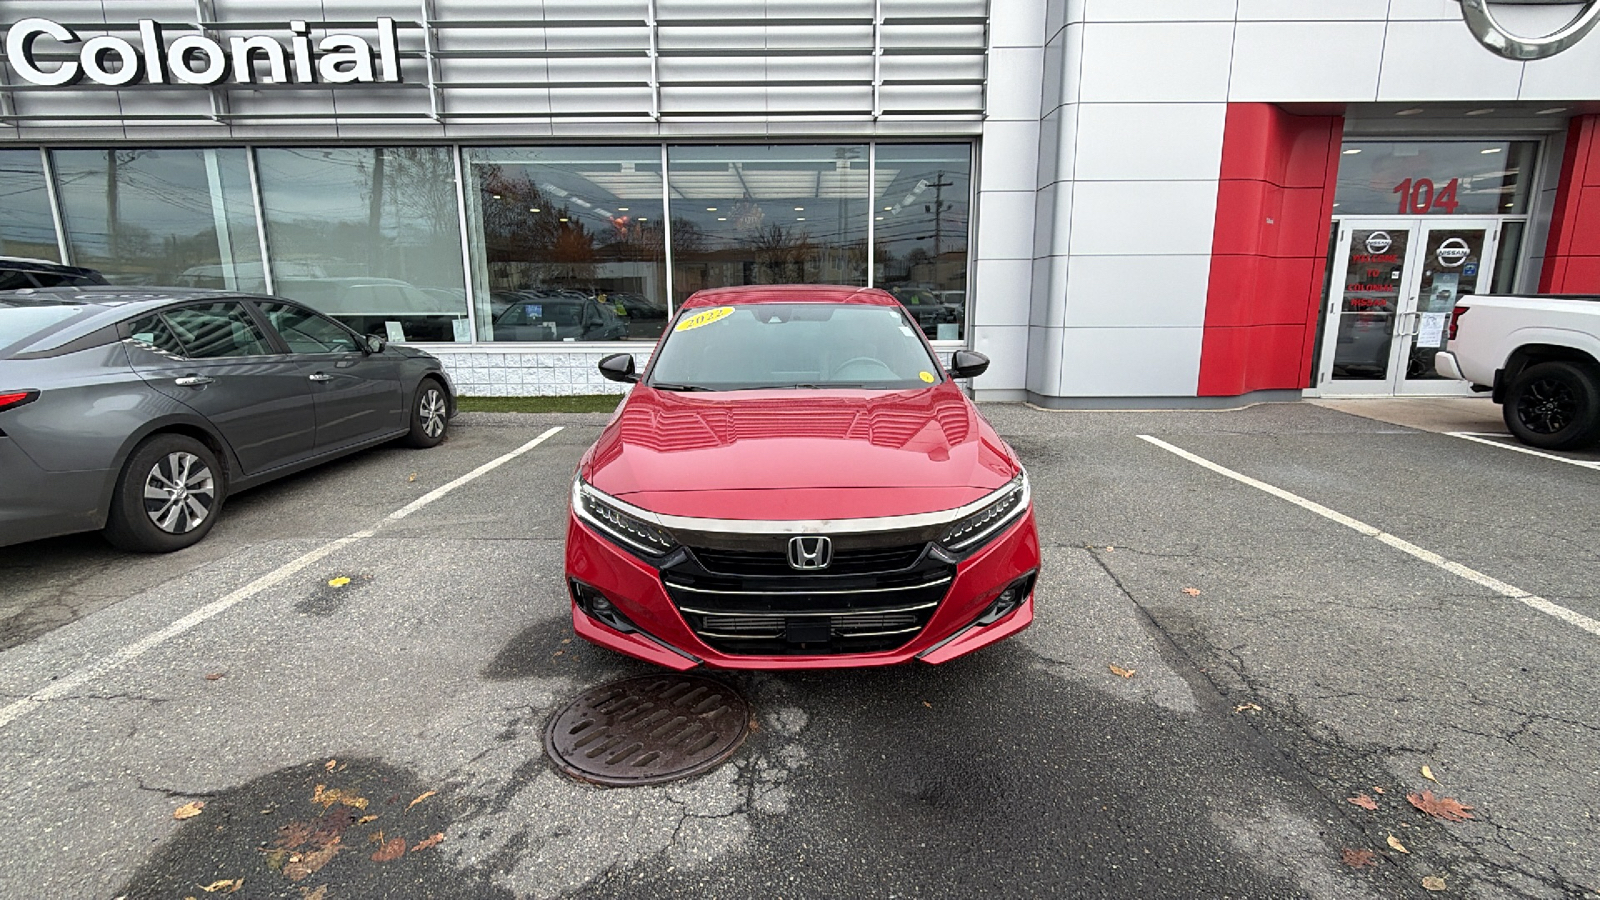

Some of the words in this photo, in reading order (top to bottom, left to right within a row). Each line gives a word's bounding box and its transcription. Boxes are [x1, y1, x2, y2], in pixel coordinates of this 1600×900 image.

[6, 17, 401, 86] Colonial
[1393, 177, 1459, 214] 104
[1352, 254, 1397, 263] WELCOME
[1367, 268, 1380, 277] TO
[1347, 284, 1393, 292] COLONIAL
[1350, 298, 1387, 306] NISSAN
[686, 308, 724, 329] 2022
